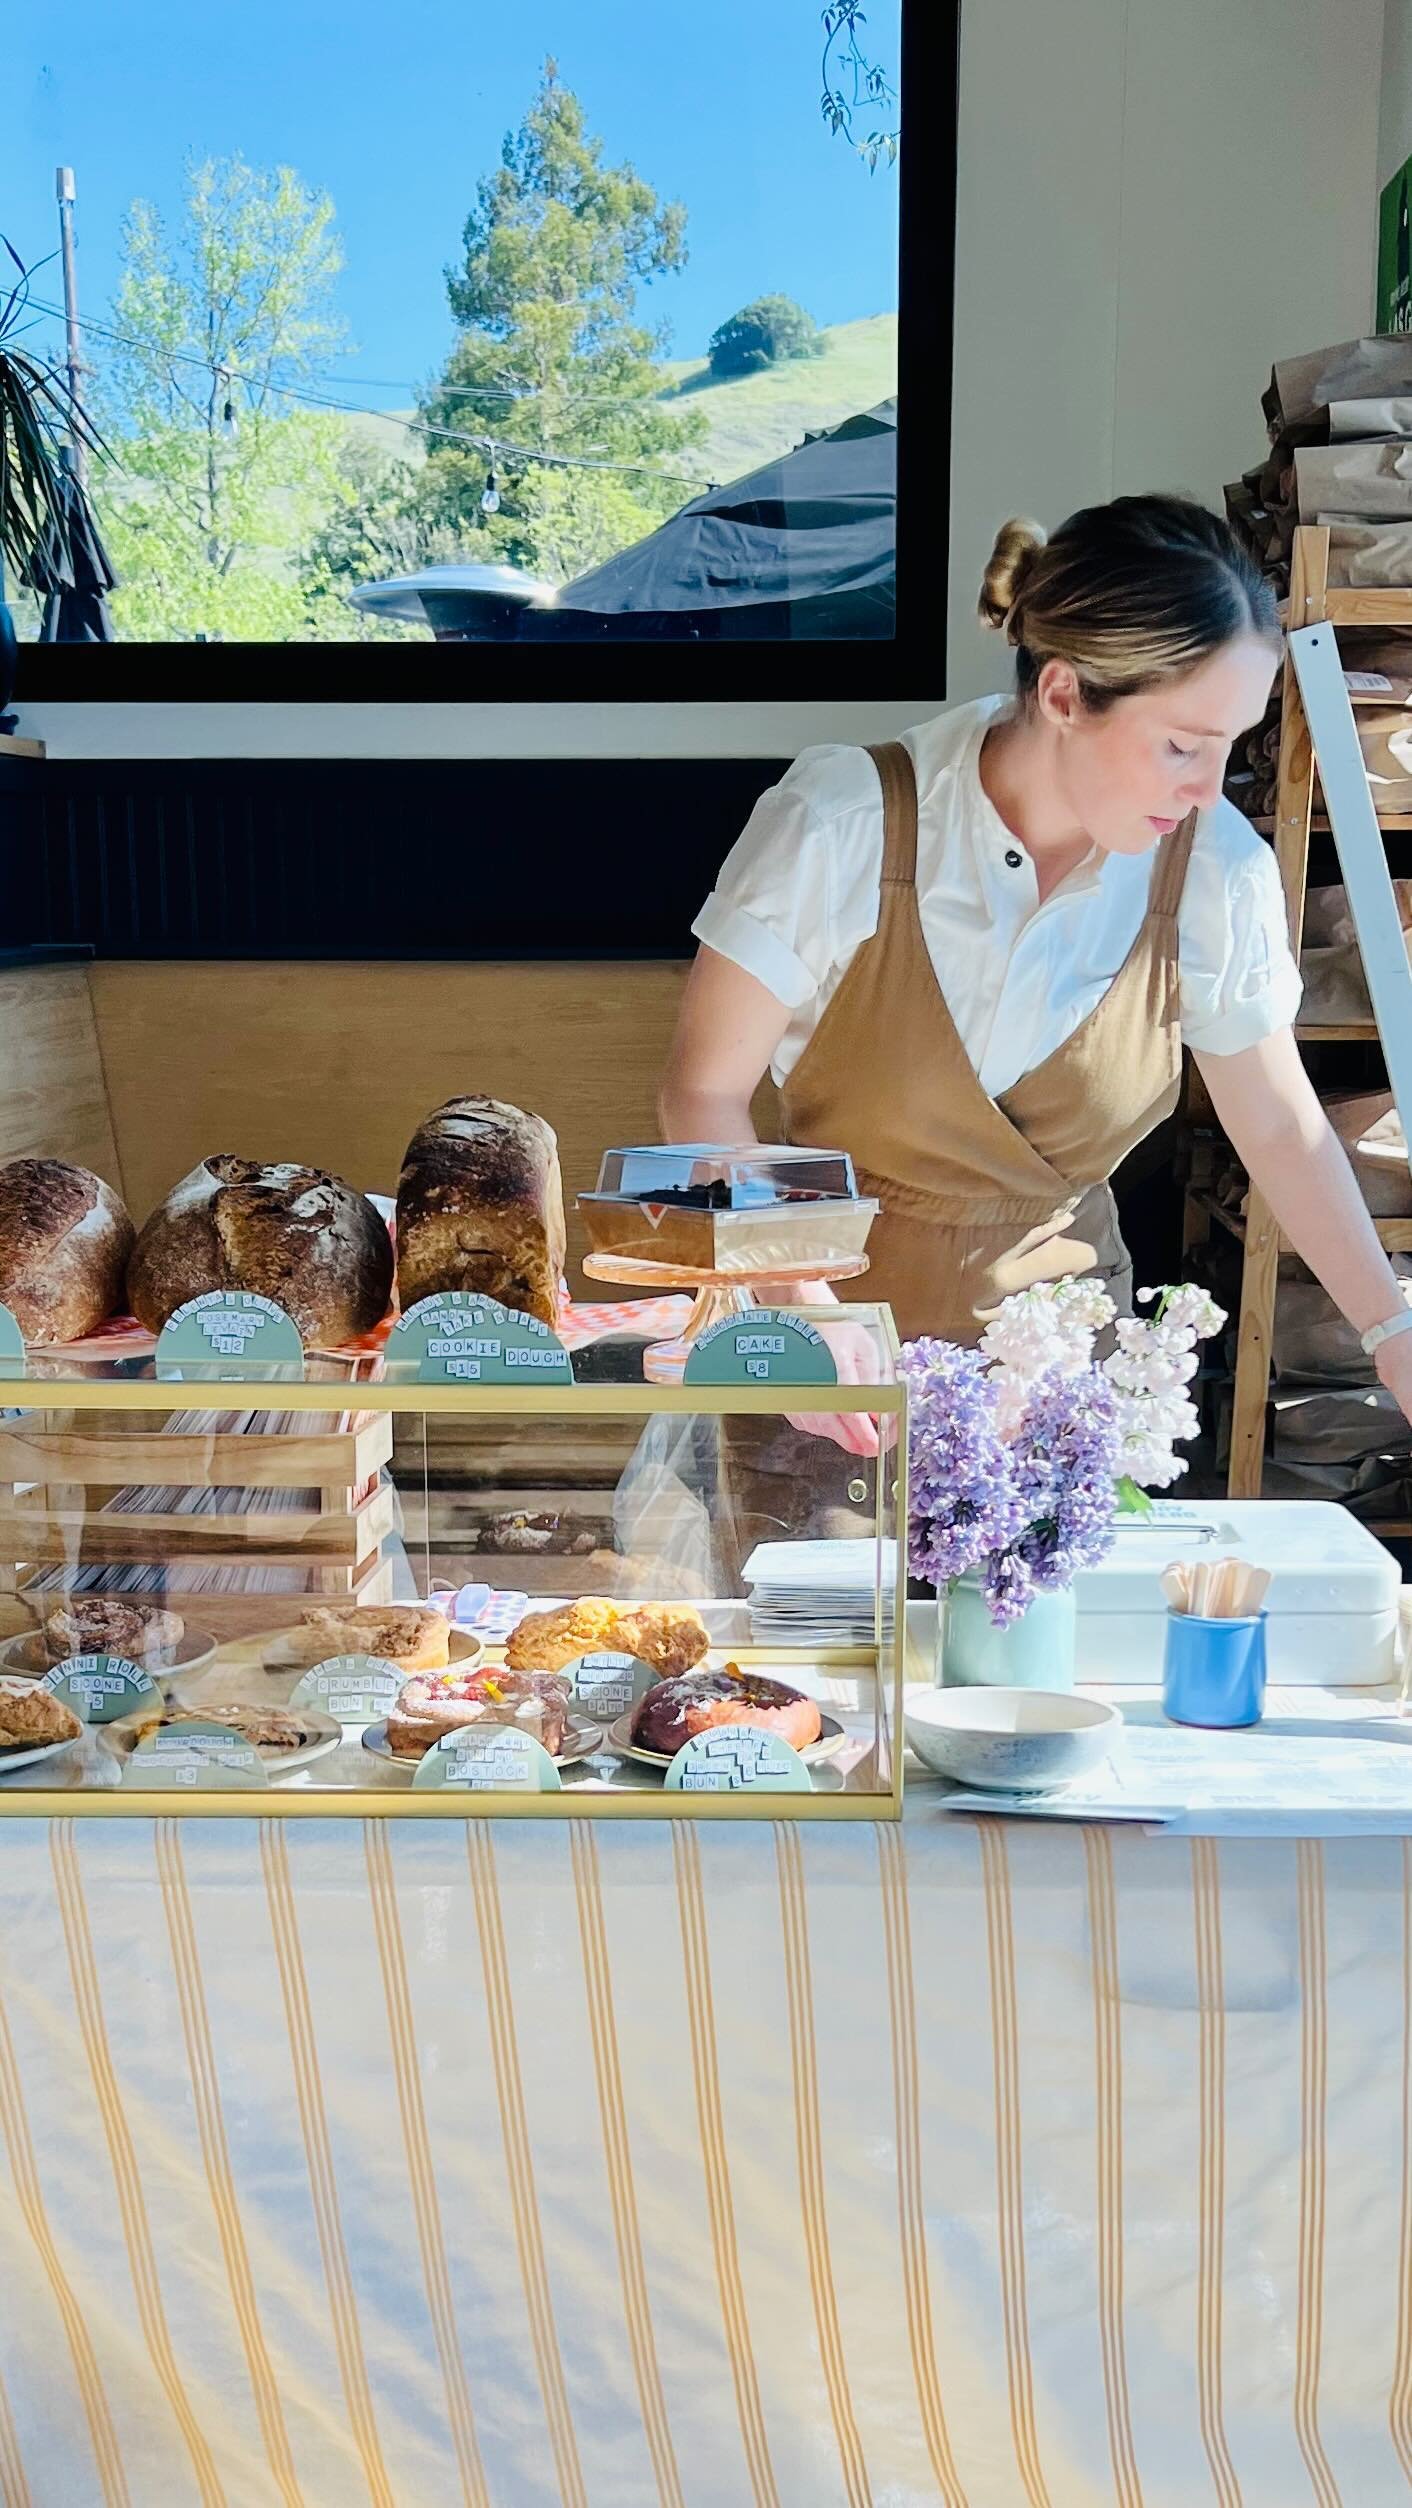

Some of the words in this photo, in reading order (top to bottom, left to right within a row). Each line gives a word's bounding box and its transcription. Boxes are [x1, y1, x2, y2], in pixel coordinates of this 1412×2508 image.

[244, 1296, 282, 1321] OLIVE
[198, 1313, 263, 1325] ROSEMARY
[510, 1311, 547, 1334] BAKE
[697, 1314, 770, 1348] CHOCOLATE
[779, 1314, 821, 1344] STOUT
[213, 1338, 242, 1351] $12
[737, 1338, 782, 1351] CAKE
[430, 1341, 498, 1354] COOKIE
[508, 1352, 564, 1363] DOUGH
[449, 1362, 478, 1374] $15
[749, 1361, 767, 1373] $8
[44, 1657, 95, 1688] CINNI
[108, 1660, 147, 1690] ROLL
[71, 1678, 123, 1690] SCONE
[319, 1679, 394, 1690] CRUMBLE
[581, 1687, 631, 1699] SCONE
[331, 1697, 359, 1709] BUN
[448, 1764, 527, 1776] BOSTOCK
[685, 1776, 717, 1788] BUN
